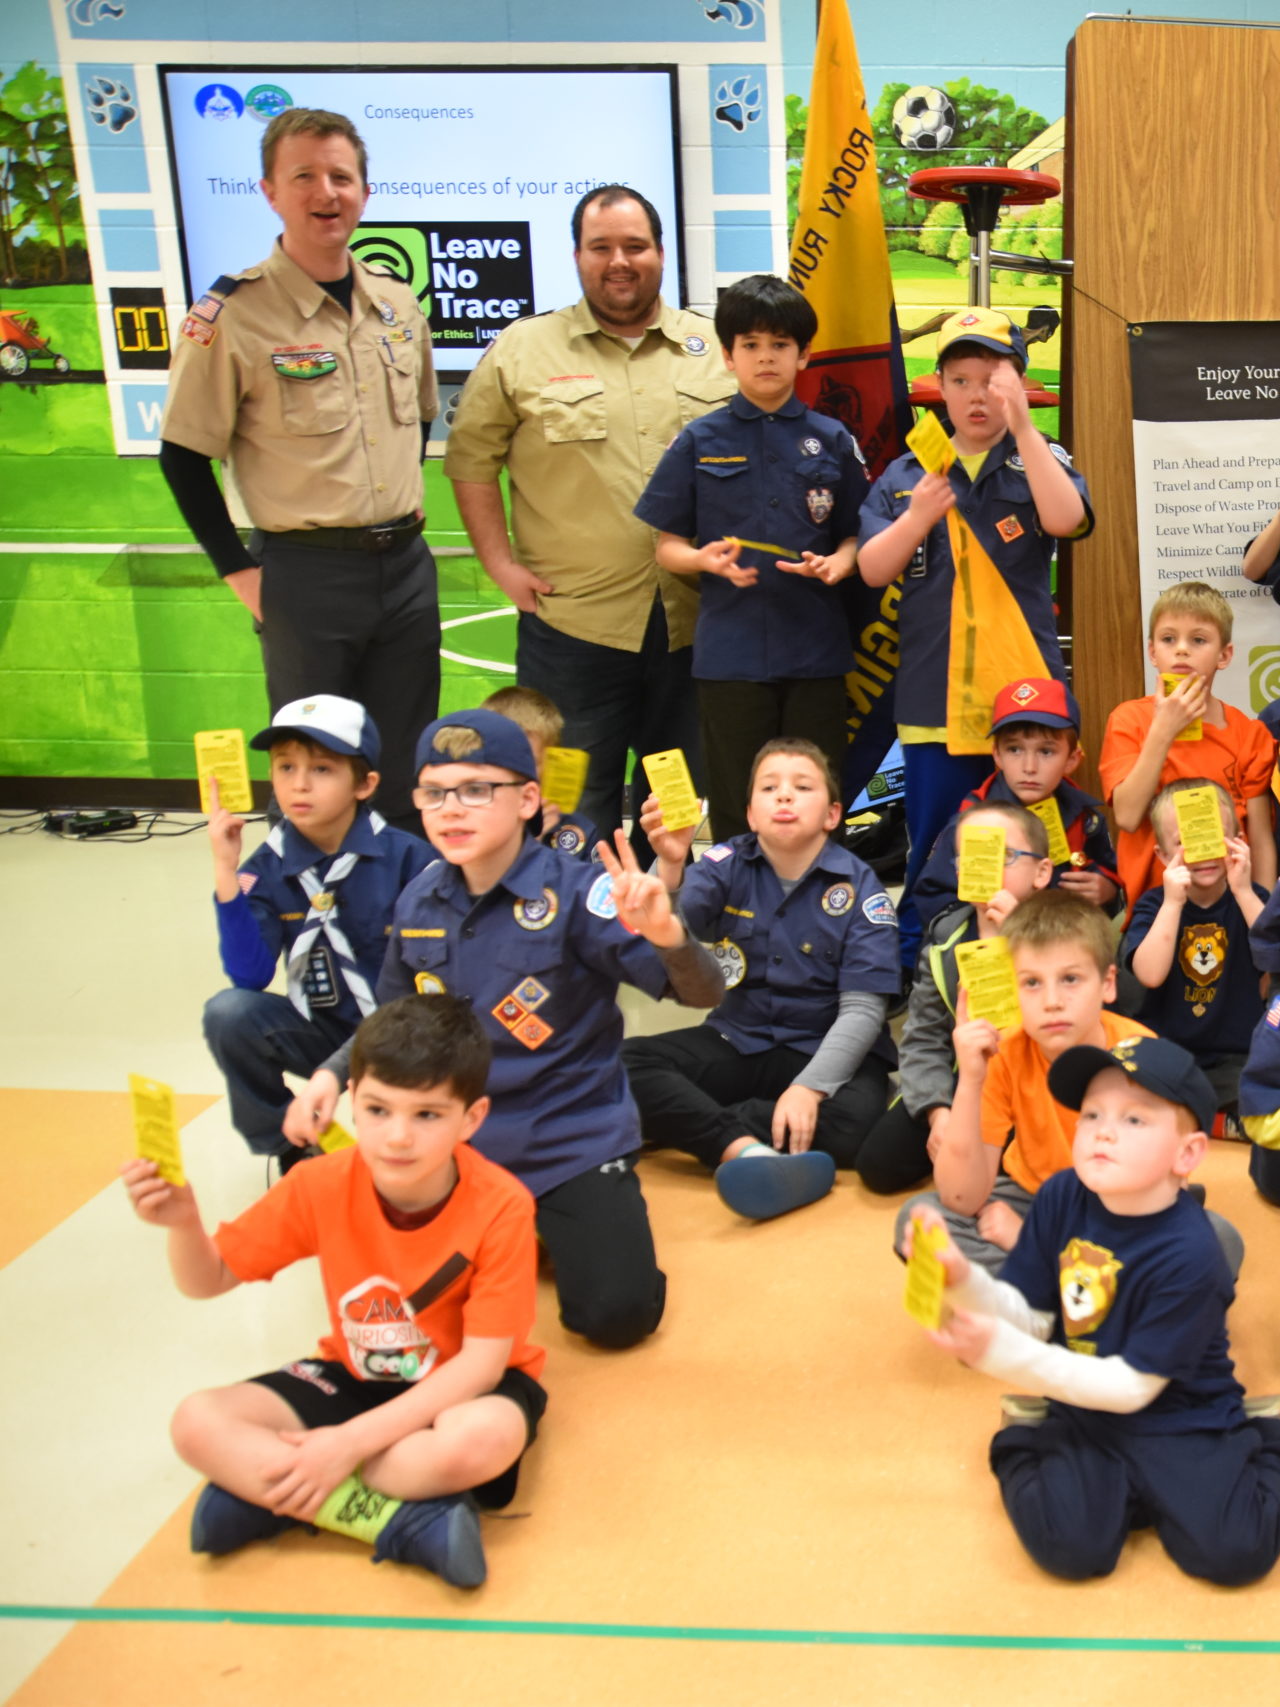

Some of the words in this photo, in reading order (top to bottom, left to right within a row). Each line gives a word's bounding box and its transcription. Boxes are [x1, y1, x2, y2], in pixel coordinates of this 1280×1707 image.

[364, 104, 474, 121] Consequences
[207, 177, 258, 195] Think
[367, 179, 487, 198] onsequences
[492, 177, 512, 195] of
[516, 180, 557, 201] your
[430, 232, 521, 259] Leave
[432, 262, 478, 289] No
[431, 330, 443, 339] or
[443, 329, 474, 339] Ethics
[1197, 367, 1241, 384] Enjoy
[1245, 365, 1280, 379] Your
[1206, 387, 1251, 401] Leave
[1255, 385, 1278, 399] No
[1153, 459, 1179, 470] Plan
[1182, 457, 1220, 469] Ahead
[1222, 456, 1245, 468] and
[1154, 479, 1191, 492] Travel
[1193, 478, 1216, 491] and
[1218, 478, 1254, 492] Camp
[1256, 479, 1272, 488] on
[1155, 503, 1202, 516] Dispose
[1204, 500, 1216, 512] of
[1218, 501, 1254, 511] Waste
[1155, 525, 1190, 536] Leave
[1192, 523, 1224, 534] What
[1226, 521, 1250, 534] You
[1157, 545, 1212, 558] Minimize
[1158, 568, 1203, 581] Respect
[1206, 565, 1245, 577] Wildli
[1249, 586, 1261, 597] of
